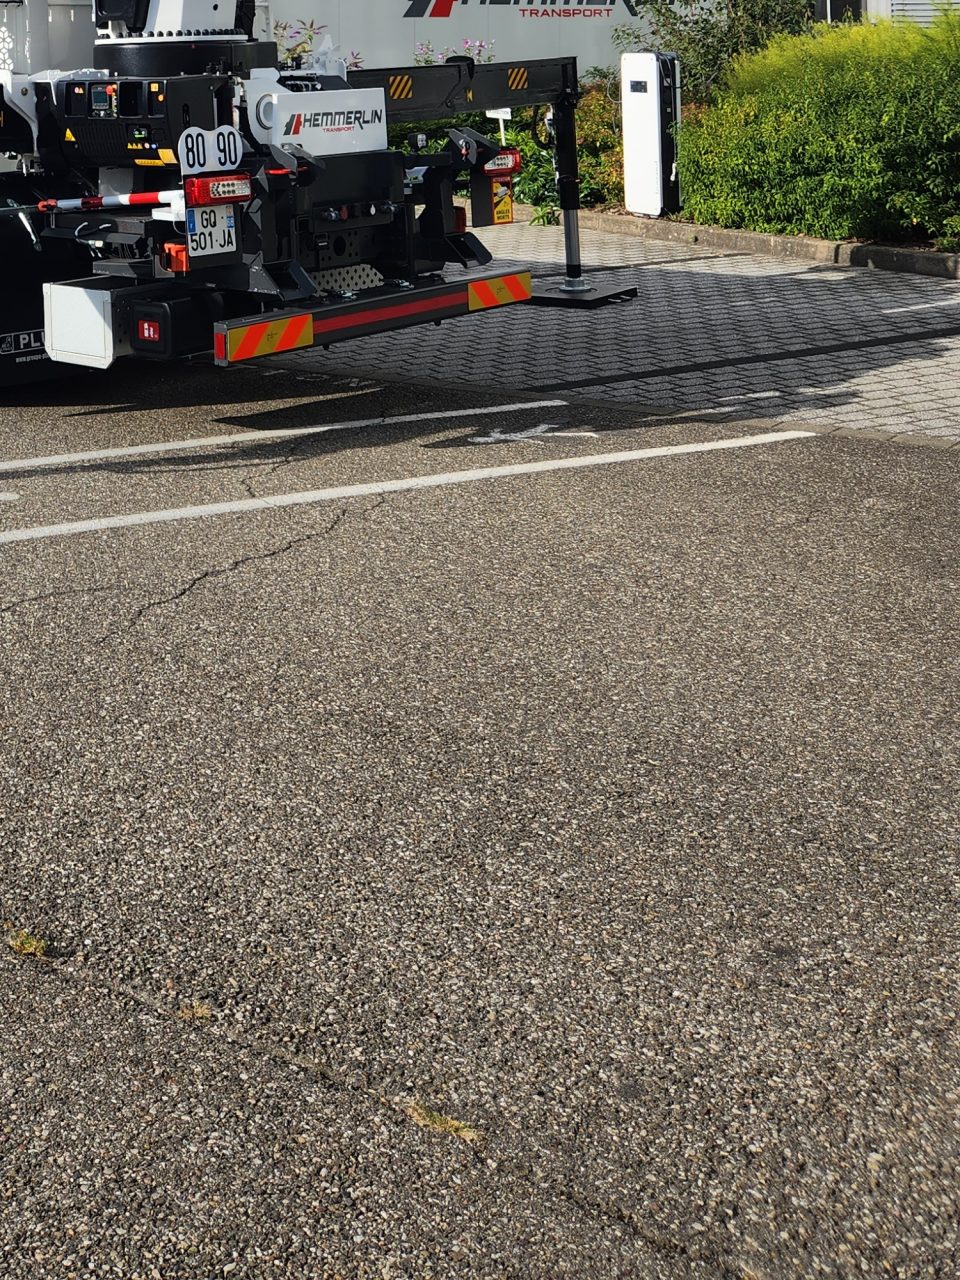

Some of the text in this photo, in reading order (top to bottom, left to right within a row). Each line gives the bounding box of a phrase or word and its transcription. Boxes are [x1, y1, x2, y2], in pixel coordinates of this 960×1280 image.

[519, 8, 613, 18] TRANSPORT
[303, 109, 383, 130] HEMMERLIN
[185, 131, 238, 169] 80 90
